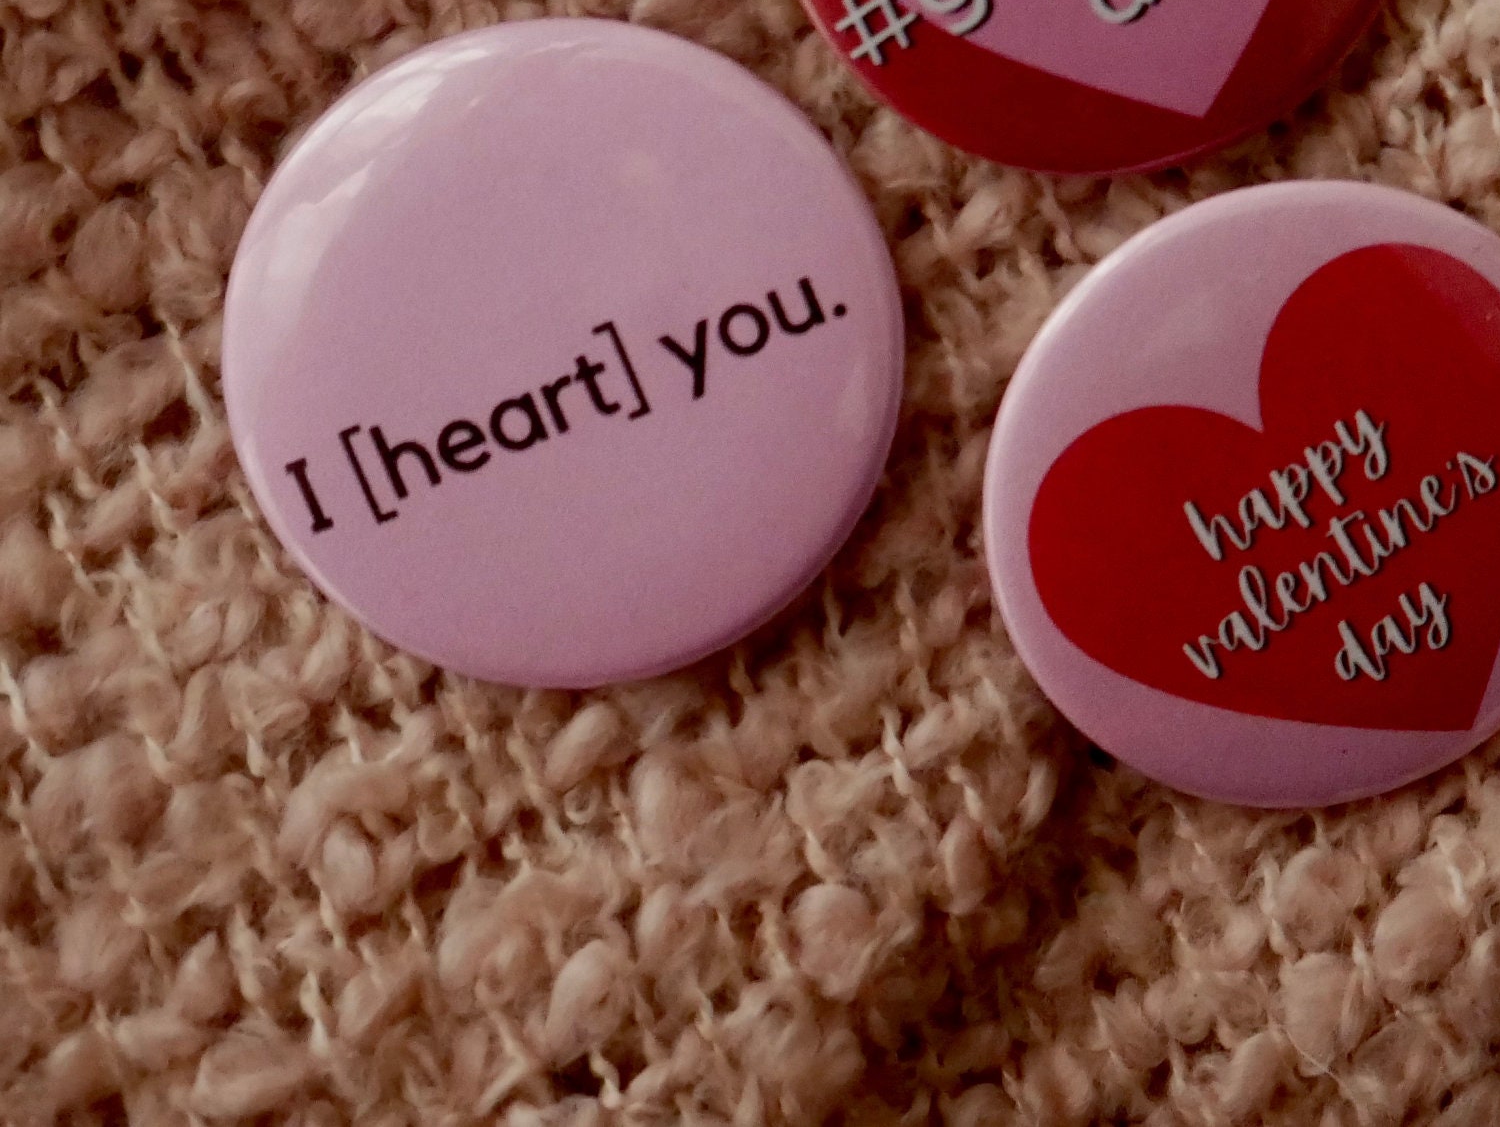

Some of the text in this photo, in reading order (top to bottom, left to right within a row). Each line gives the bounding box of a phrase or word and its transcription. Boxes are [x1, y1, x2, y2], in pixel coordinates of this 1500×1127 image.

[285, 276, 848, 535] I [heart] you.
[1182, 407, 1389, 562] happy
[1182, 450, 1500, 680] valentine's
[1332, 581, 1451, 682] day
